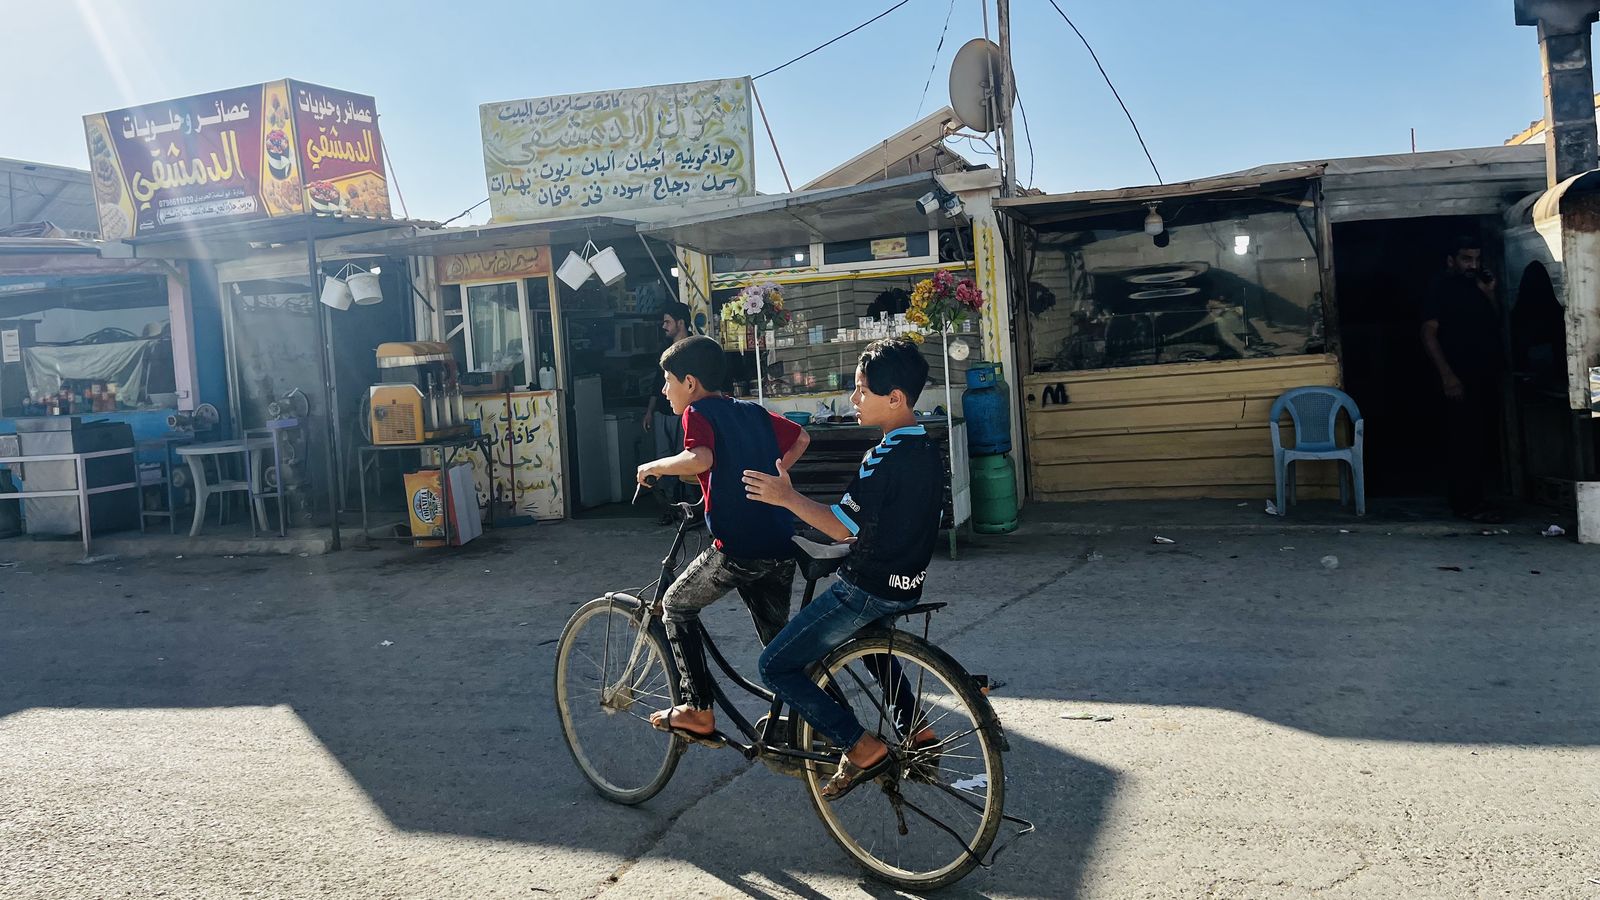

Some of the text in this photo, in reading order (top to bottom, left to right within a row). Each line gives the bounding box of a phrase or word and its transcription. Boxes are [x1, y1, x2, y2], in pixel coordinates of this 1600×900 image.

[195, 100, 250, 133] عصائر
[343, 99, 372, 124] عصائر
[306, 125, 377, 170] الدمشقي
[711, 145, 735, 166] مواد
[132, 130, 245, 211] الدمشقي
[540, 158, 573, 182] زيوت
[490, 173, 532, 197] بهارات
[653, 175, 691, 200] دجاج
